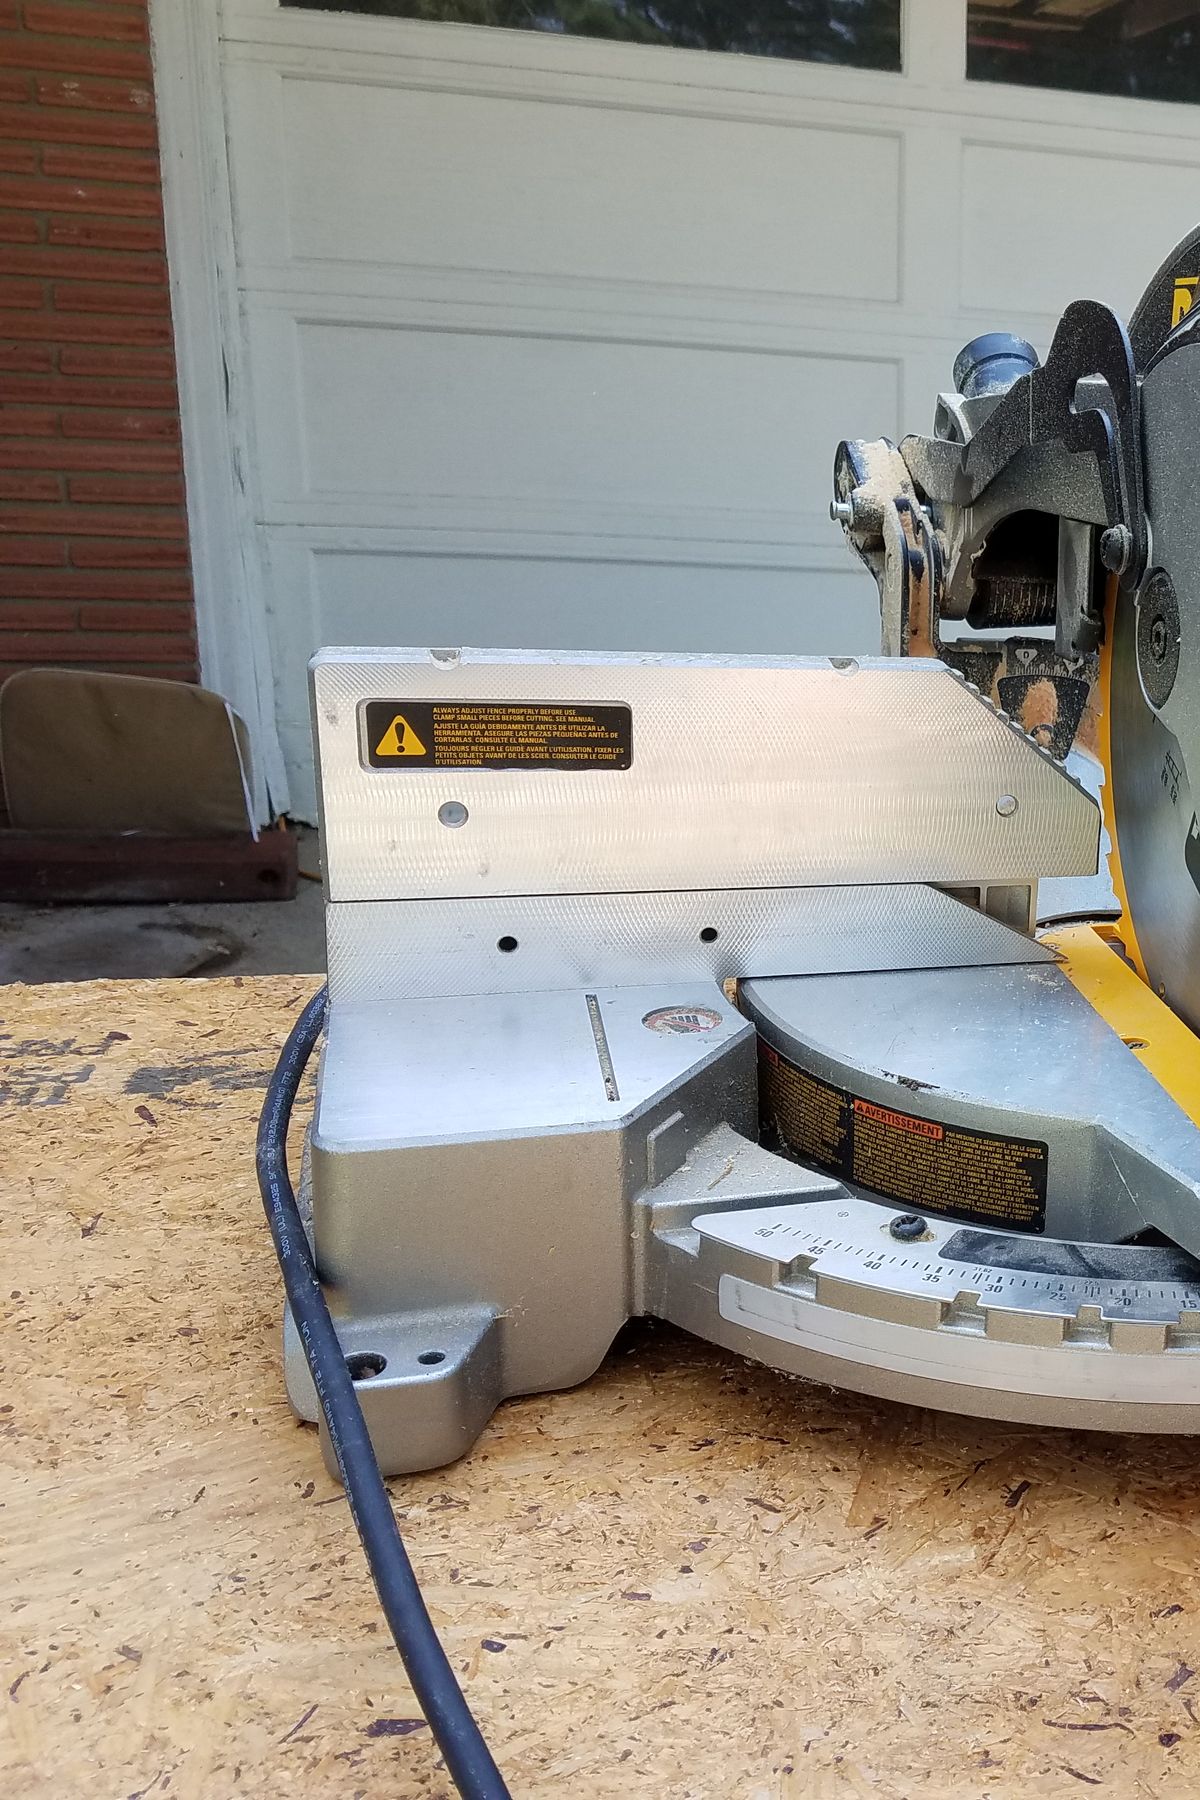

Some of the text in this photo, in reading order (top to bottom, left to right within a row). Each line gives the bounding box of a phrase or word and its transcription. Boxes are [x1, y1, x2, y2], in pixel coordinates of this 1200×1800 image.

[289, 1047, 300, 1065] 300V
[296, 1030, 308, 1044] CSA
[864, 1106, 941, 1137] AVERTISSEMENT
[754, 1228, 774, 1238] 50
[807, 1245, 827, 1255] 45
[863, 1260, 882, 1270] 40
[922, 1273, 941, 1283] 35
[985, 1284, 1004, 1294] 30
[1050, 1291, 1067, 1301] 25
[1114, 1297, 1132, 1307] 20
[1181, 1300, 1197, 1309] 15
